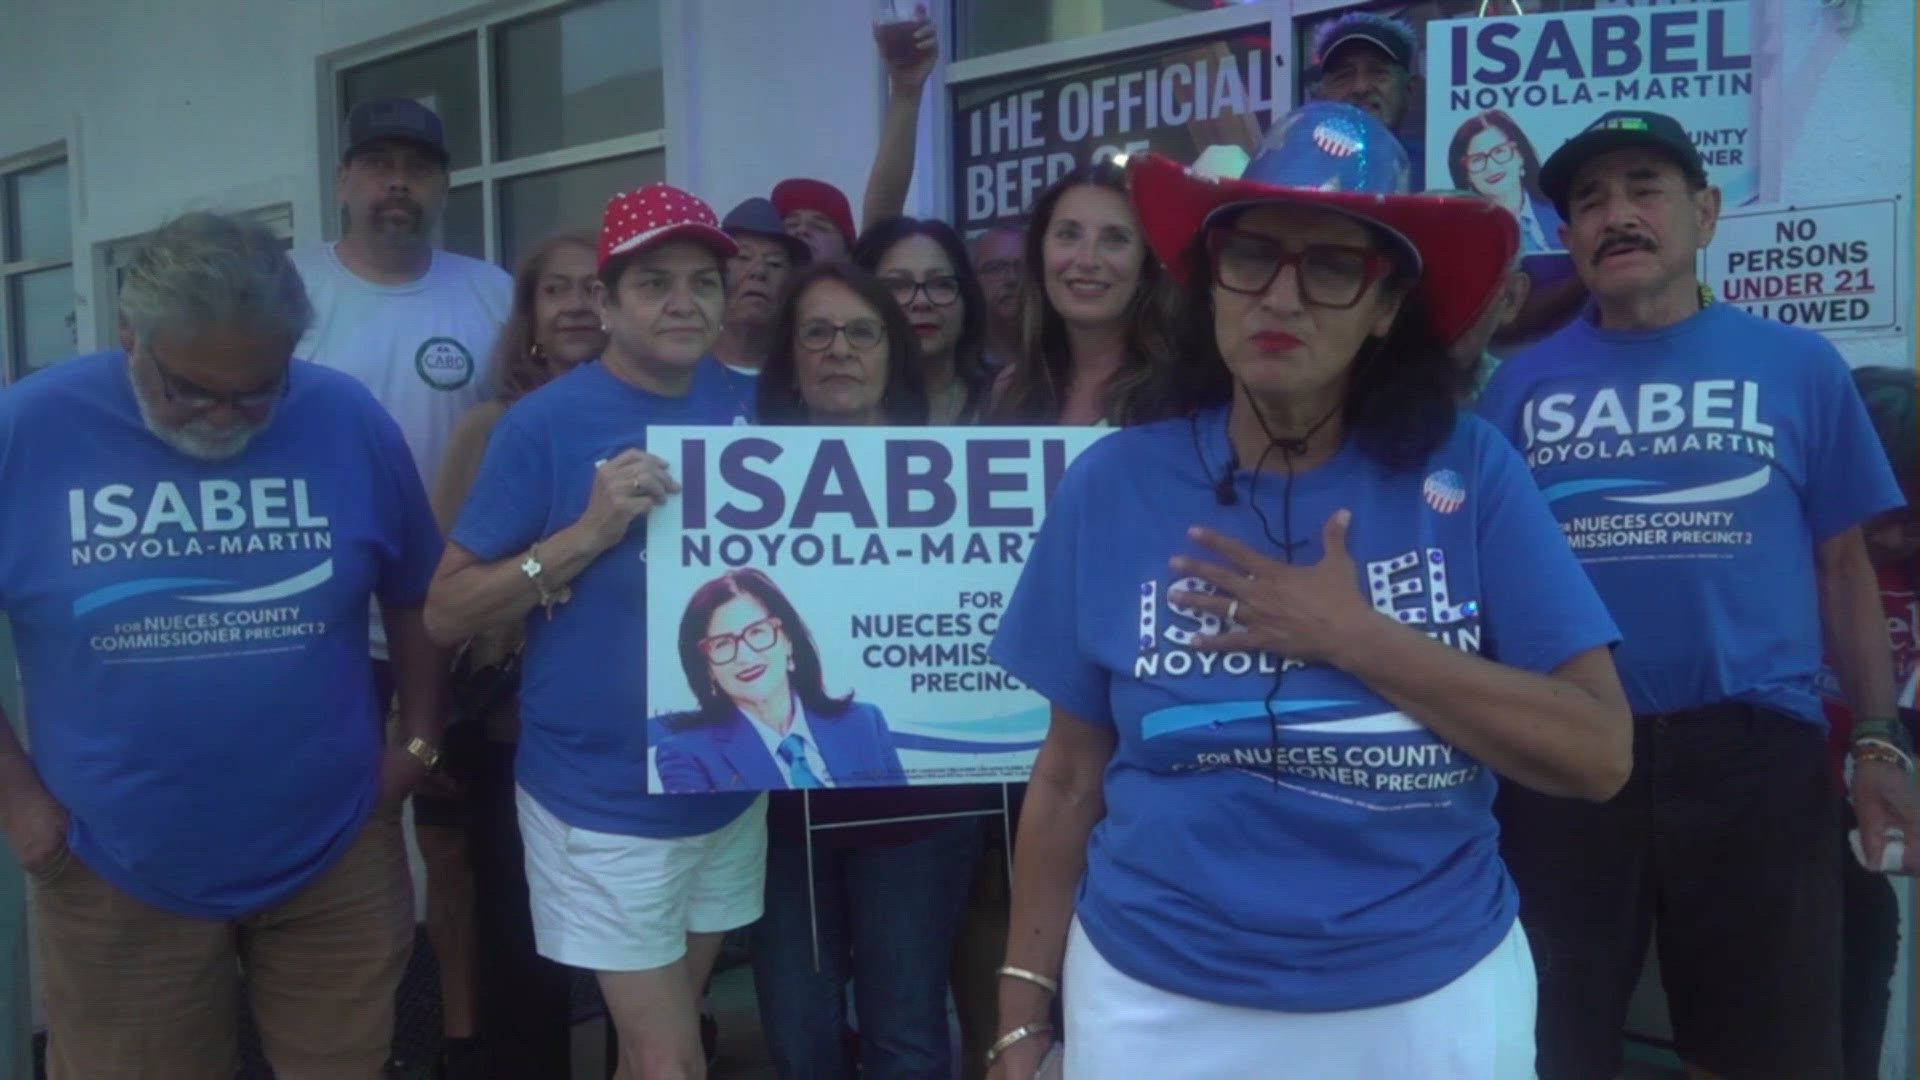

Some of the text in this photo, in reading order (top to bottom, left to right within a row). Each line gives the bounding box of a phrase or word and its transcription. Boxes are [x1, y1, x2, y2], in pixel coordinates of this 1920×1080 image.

[1451, 9, 1752, 86] ISABEL
[1058, 50, 1272, 142] OFFICIAL
[1450, 73, 1753, 111] NOYOLA-MARTIN
[1689, 128, 1748, 147] UNTY
[1776, 219, 1816, 243] NO
[1728, 241, 1868, 274] PERSONS
[1723, 268, 1875, 301] UNDER 21
[1746, 298, 1870, 325] OWED
[1523, 380, 1774, 449] ISABEL
[68, 478, 329, 542] ISABEL
[1573, 514, 1646, 532] NUECES
[1650, 511, 1734, 528] COUNTY
[72, 532, 332, 566] NOYOLA-MARTIN
[681, 532, 1036, 567] NOYOLA-MAR
[1567, 530, 1753, 548] MISSIONER PRECINCT 2
[959, 591, 1003, 609] FOR
[1139, 547, 1478, 651] ISEL
[114, 606, 300, 634] FOR NUECES COUNTY
[851, 613, 972, 638] NUECES
[89, 622, 326, 652] COMMISSIONER PRECINCT 2
[862, 643, 994, 668] COMMIS
[911, 671, 1034, 693] PRECINC
[1197, 745, 1453, 767] FOR NUECES COUNTY
[1375, 767, 1467, 792] PRECINCT
